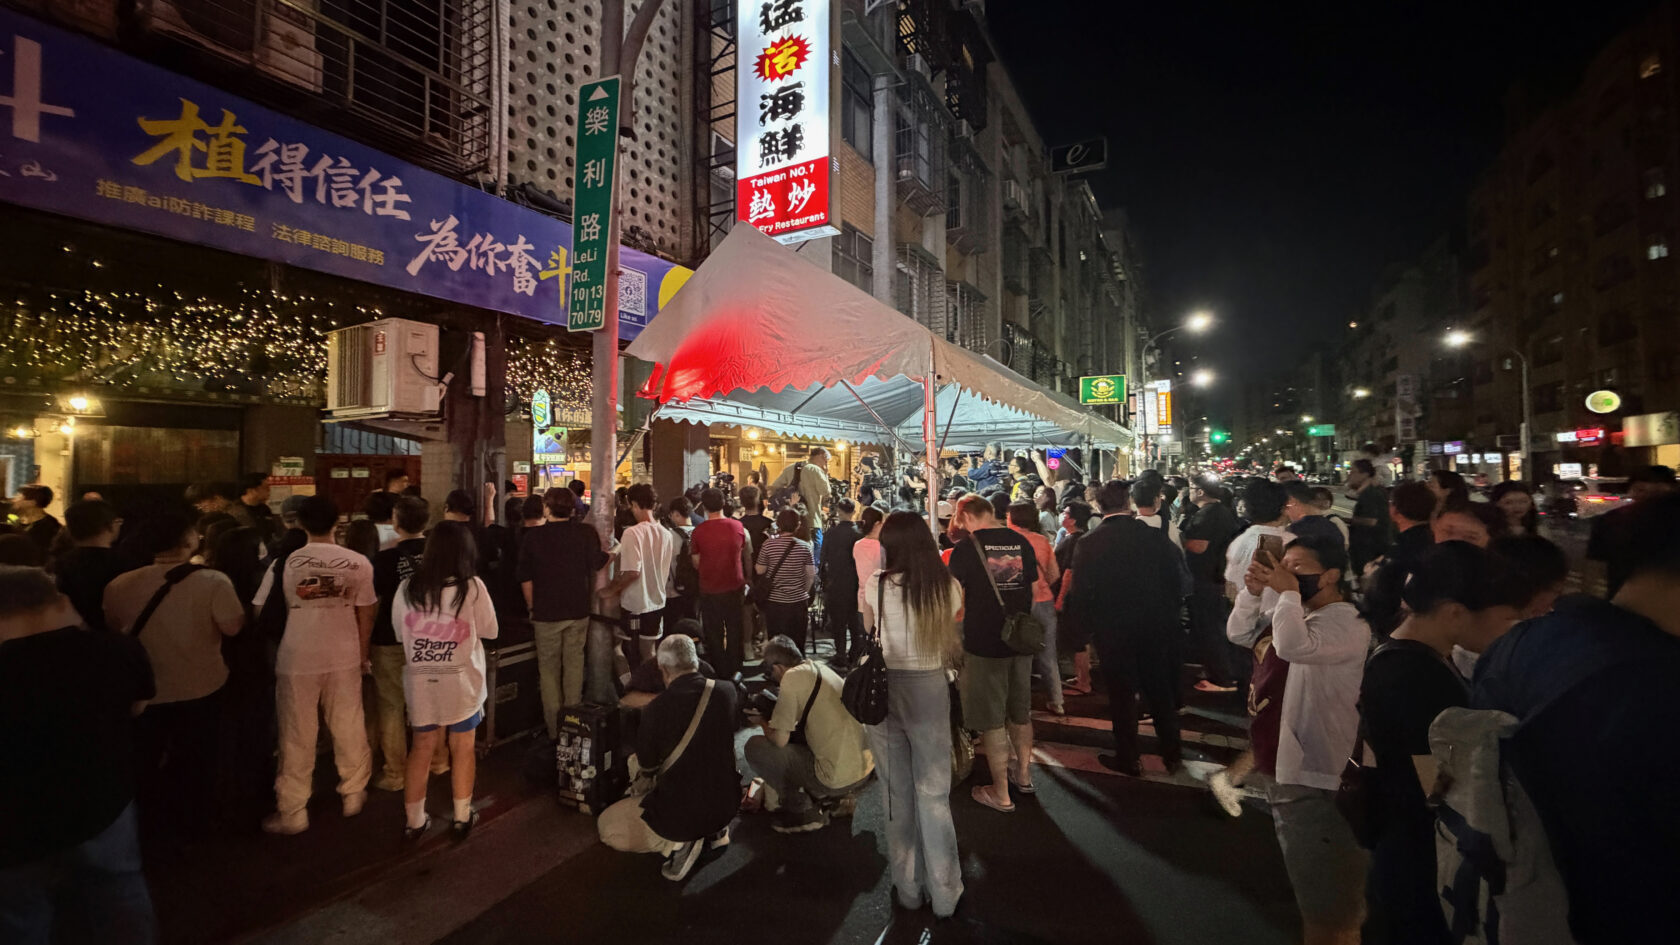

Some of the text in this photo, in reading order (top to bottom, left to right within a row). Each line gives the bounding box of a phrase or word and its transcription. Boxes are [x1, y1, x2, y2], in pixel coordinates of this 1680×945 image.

[131, 97, 411, 221] 植得信任
[580, 106, 609, 243] 樂利路
[750, 163, 815, 188] Taiwan NO.1
[748, 178, 816, 224] 熱炒
[775, 212, 825, 230] Restaurant
[272, 222, 385, 265] 法律諮詢服務
[406, 214, 572, 310] 為你奮斗
[574, 248, 597, 264] LeLi
[573, 269, 590, 283] Rd.
[573, 284, 603, 301] 10 13
[571, 310, 601, 325] 70 79
[289, 556, 327, 568] Fresh
[413, 638, 458, 652] Sharp
[412, 650, 454, 663] &Soft
